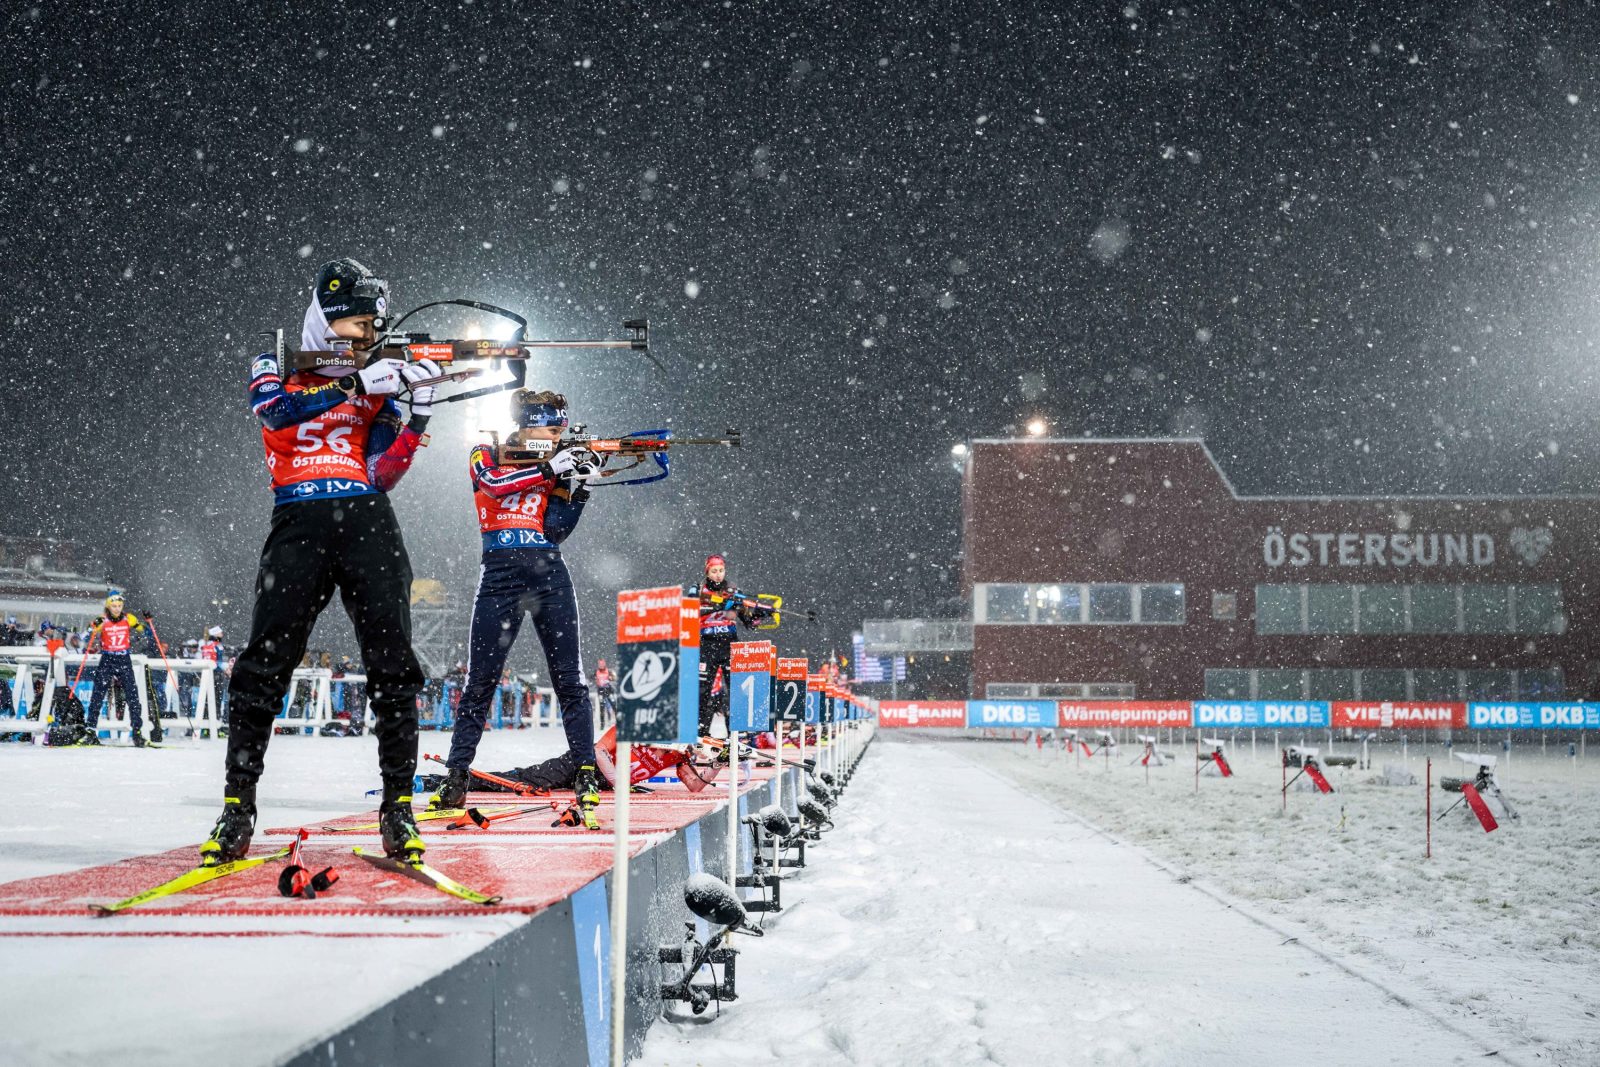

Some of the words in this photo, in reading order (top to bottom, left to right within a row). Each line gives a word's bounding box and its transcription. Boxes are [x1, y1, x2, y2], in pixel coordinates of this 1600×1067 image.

[410, 345, 452, 357] VIESSMANN
[320, 410, 364, 425] pumps
[296, 421, 353, 455] 56
[480, 507, 488, 519] 8
[500, 492, 542, 516] 48
[519, 530, 547, 544] iX3
[1263, 525, 1496, 568] ÖSTERSUND
[619, 594, 681, 617] VIESSMANN
[624, 625, 644, 637] Heat
[645, 623, 673, 637] pumps
[110, 635, 126, 646] 17
[731, 643, 770, 658] VIESSMANN
[748, 662, 765, 670] pumps
[778, 660, 807, 670] VIESSMANN
[741, 675, 755, 728] 1
[783, 681, 799, 720] 2
[805, 692, 815, 722] 3
[634, 708, 658, 725] IBU
[881, 704, 964, 724] VIESSMANN
[982, 705, 1027, 723] DKB
[1062, 704, 1188, 724] Wärmepumpen
[1200, 704, 1244, 723] DKB
[1264, 704, 1308, 723] DKB
[1345, 702, 1452, 727] VIESSMANN
[1473, 705, 1519, 725] DKB
[1540, 706, 1585, 725] DKB
[215, 862, 235, 876] FISCHER
